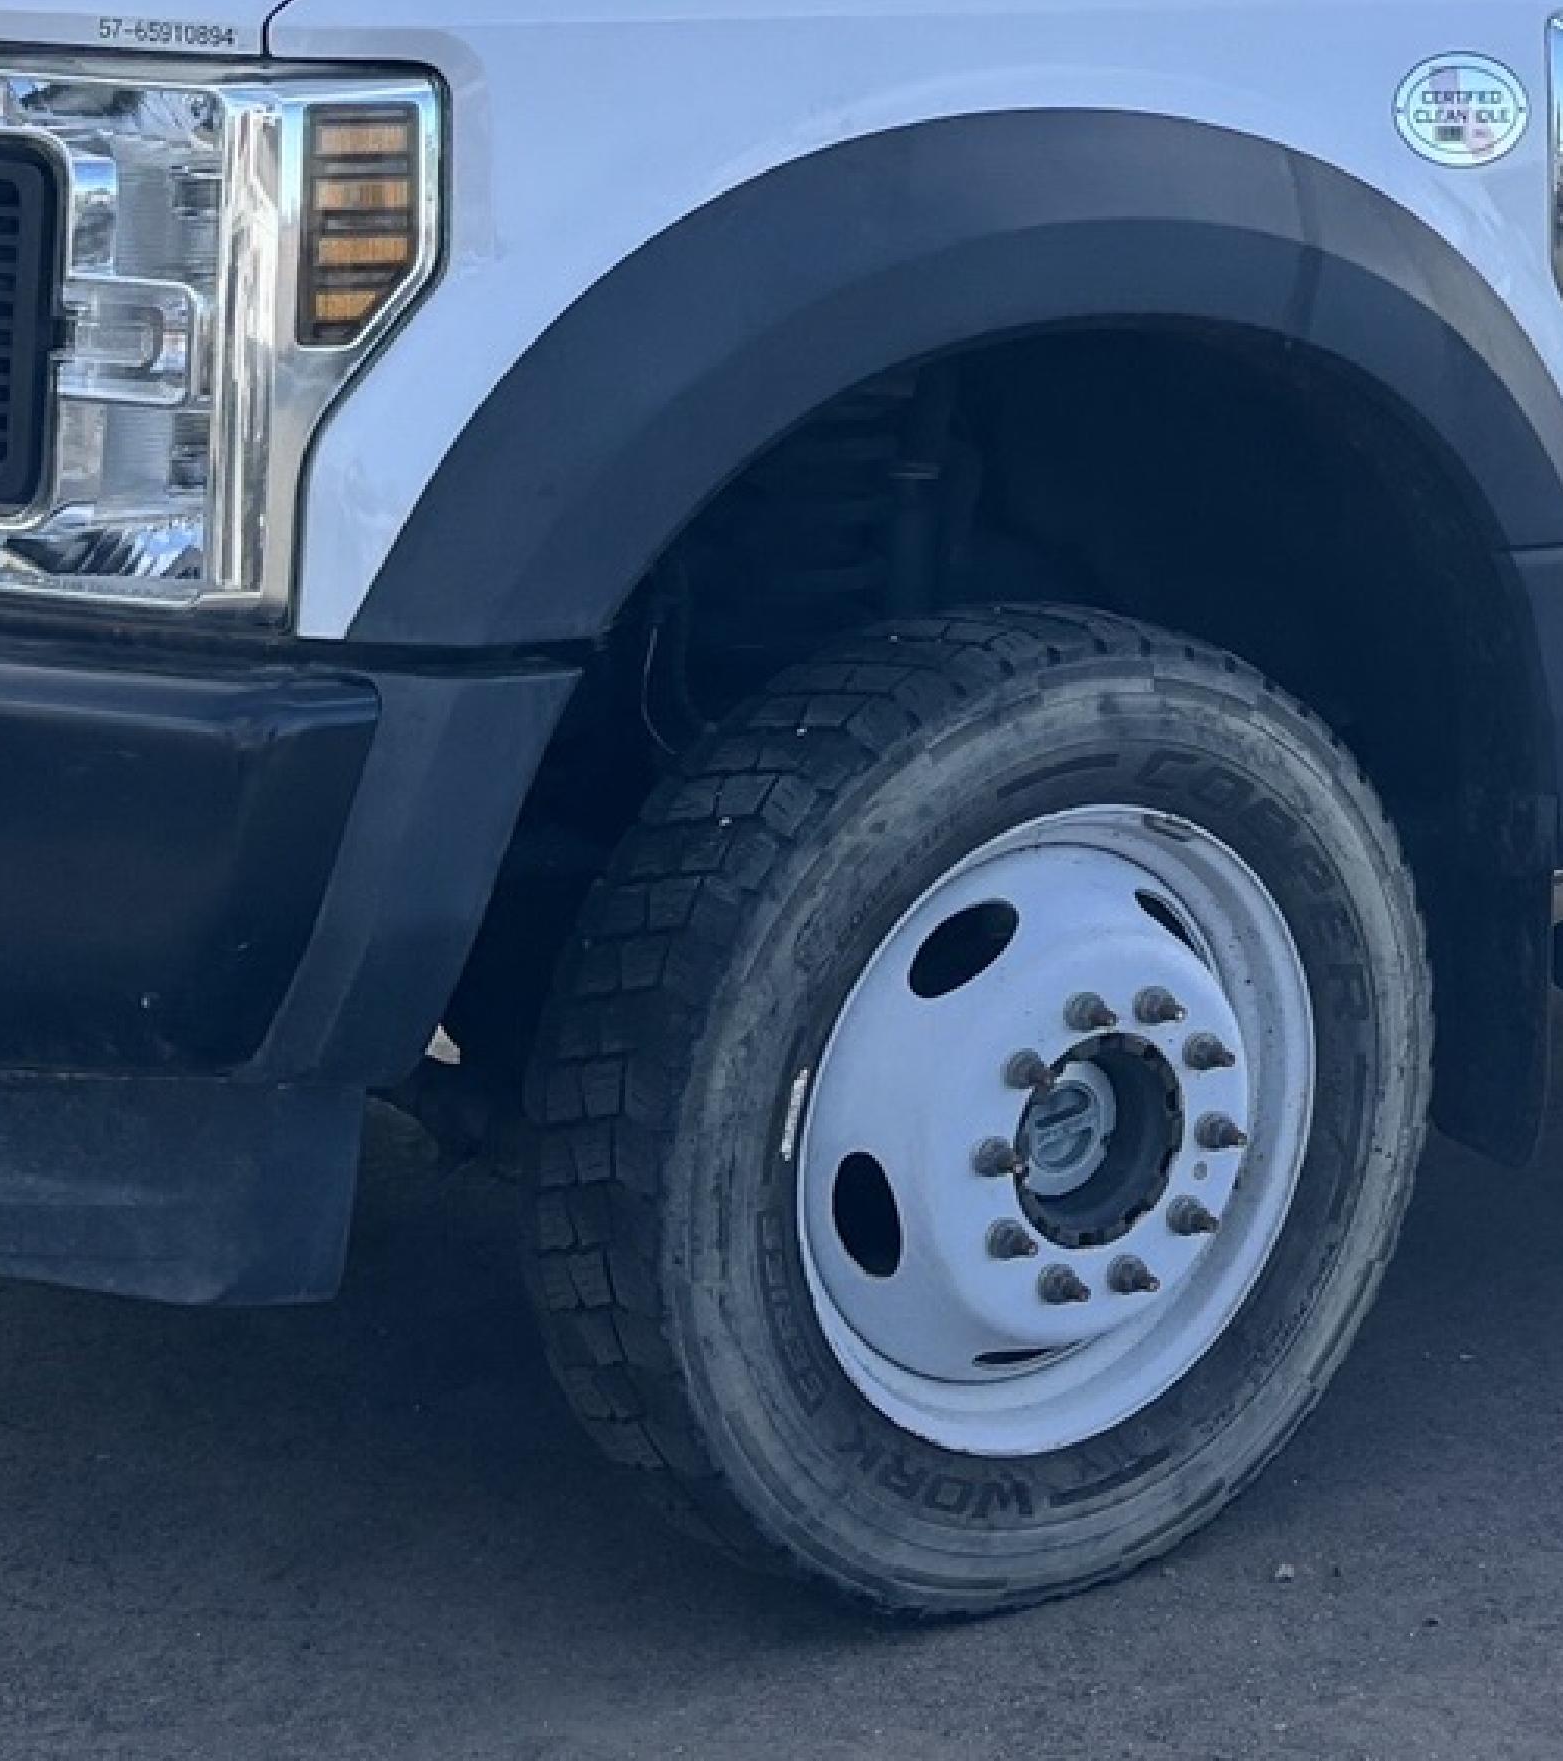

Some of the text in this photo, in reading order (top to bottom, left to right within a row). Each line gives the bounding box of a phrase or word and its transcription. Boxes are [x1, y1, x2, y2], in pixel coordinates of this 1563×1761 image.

[1421, 90, 1503, 105] CERTIFIED
[1413, 109, 1470, 124] CLEAN
[832, 1426, 1036, 1521] WORK
